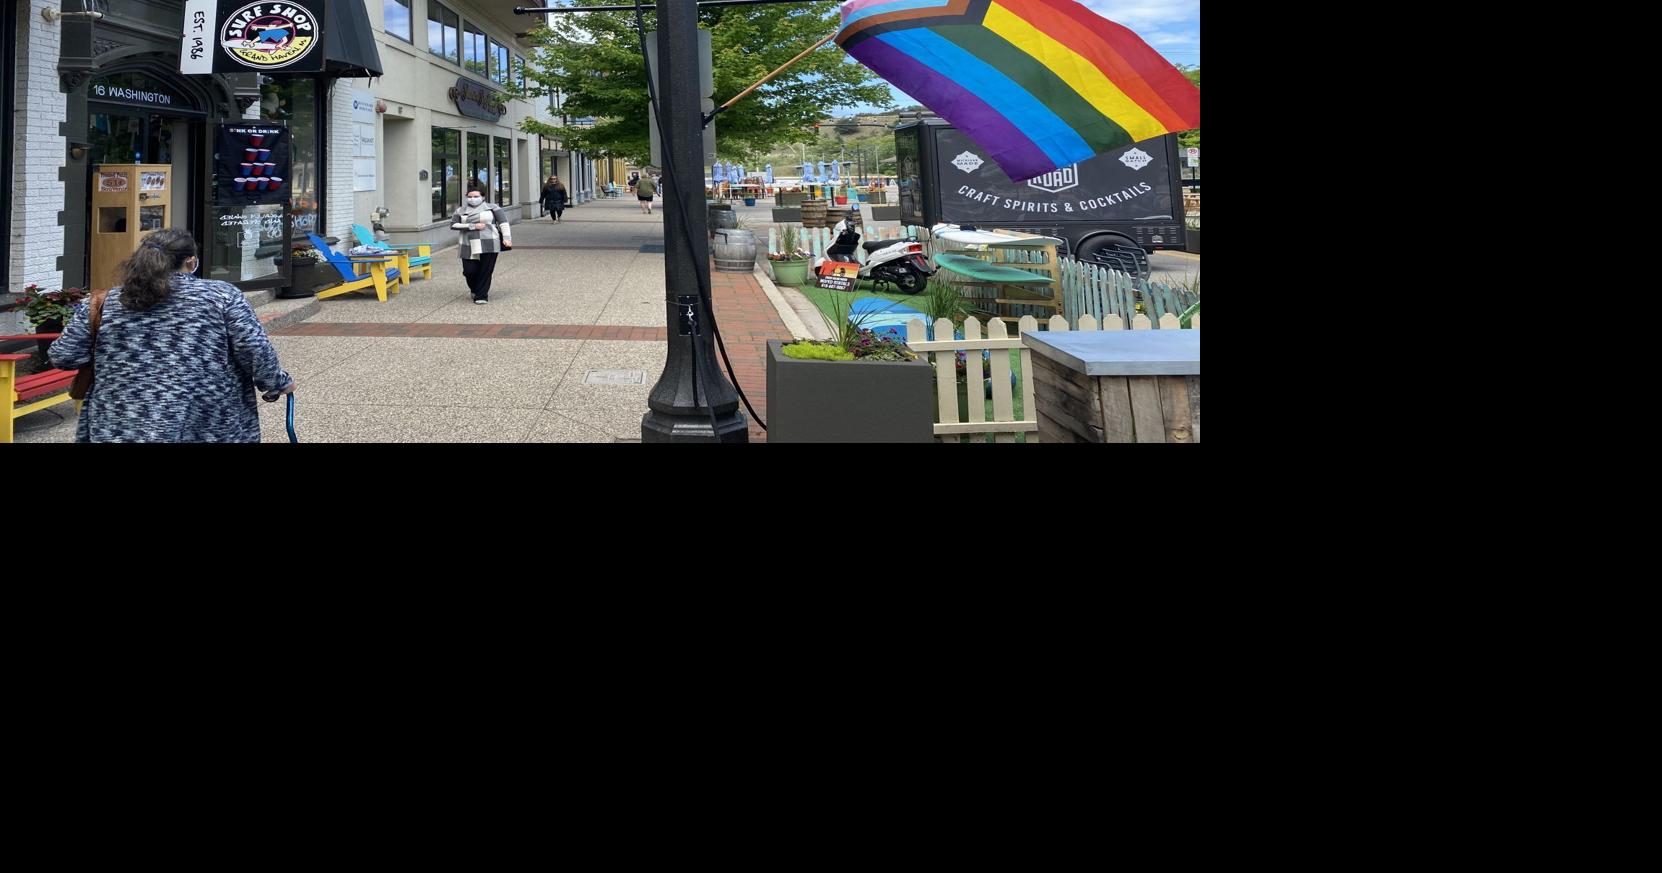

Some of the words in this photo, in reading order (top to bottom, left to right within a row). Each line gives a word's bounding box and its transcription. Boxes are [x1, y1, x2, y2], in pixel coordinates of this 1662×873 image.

[193, 11, 205, 33] EST.
[228, 6, 262, 37] SURF
[269, 4, 312, 31] SHOP
[190, 37, 204, 60] 1986
[239, 49, 269, 61] GRAND
[270, 46, 301, 60] HAVEN
[93, 84, 106, 96] 16
[108, 86, 171, 104] WASHINGTON
[958, 185, 1000, 206] CRAFT
[1003, 198, 1058, 213] SPIRITS
[1064, 203, 1074, 212] &
[1079, 181, 1152, 211] COCKTAILS
